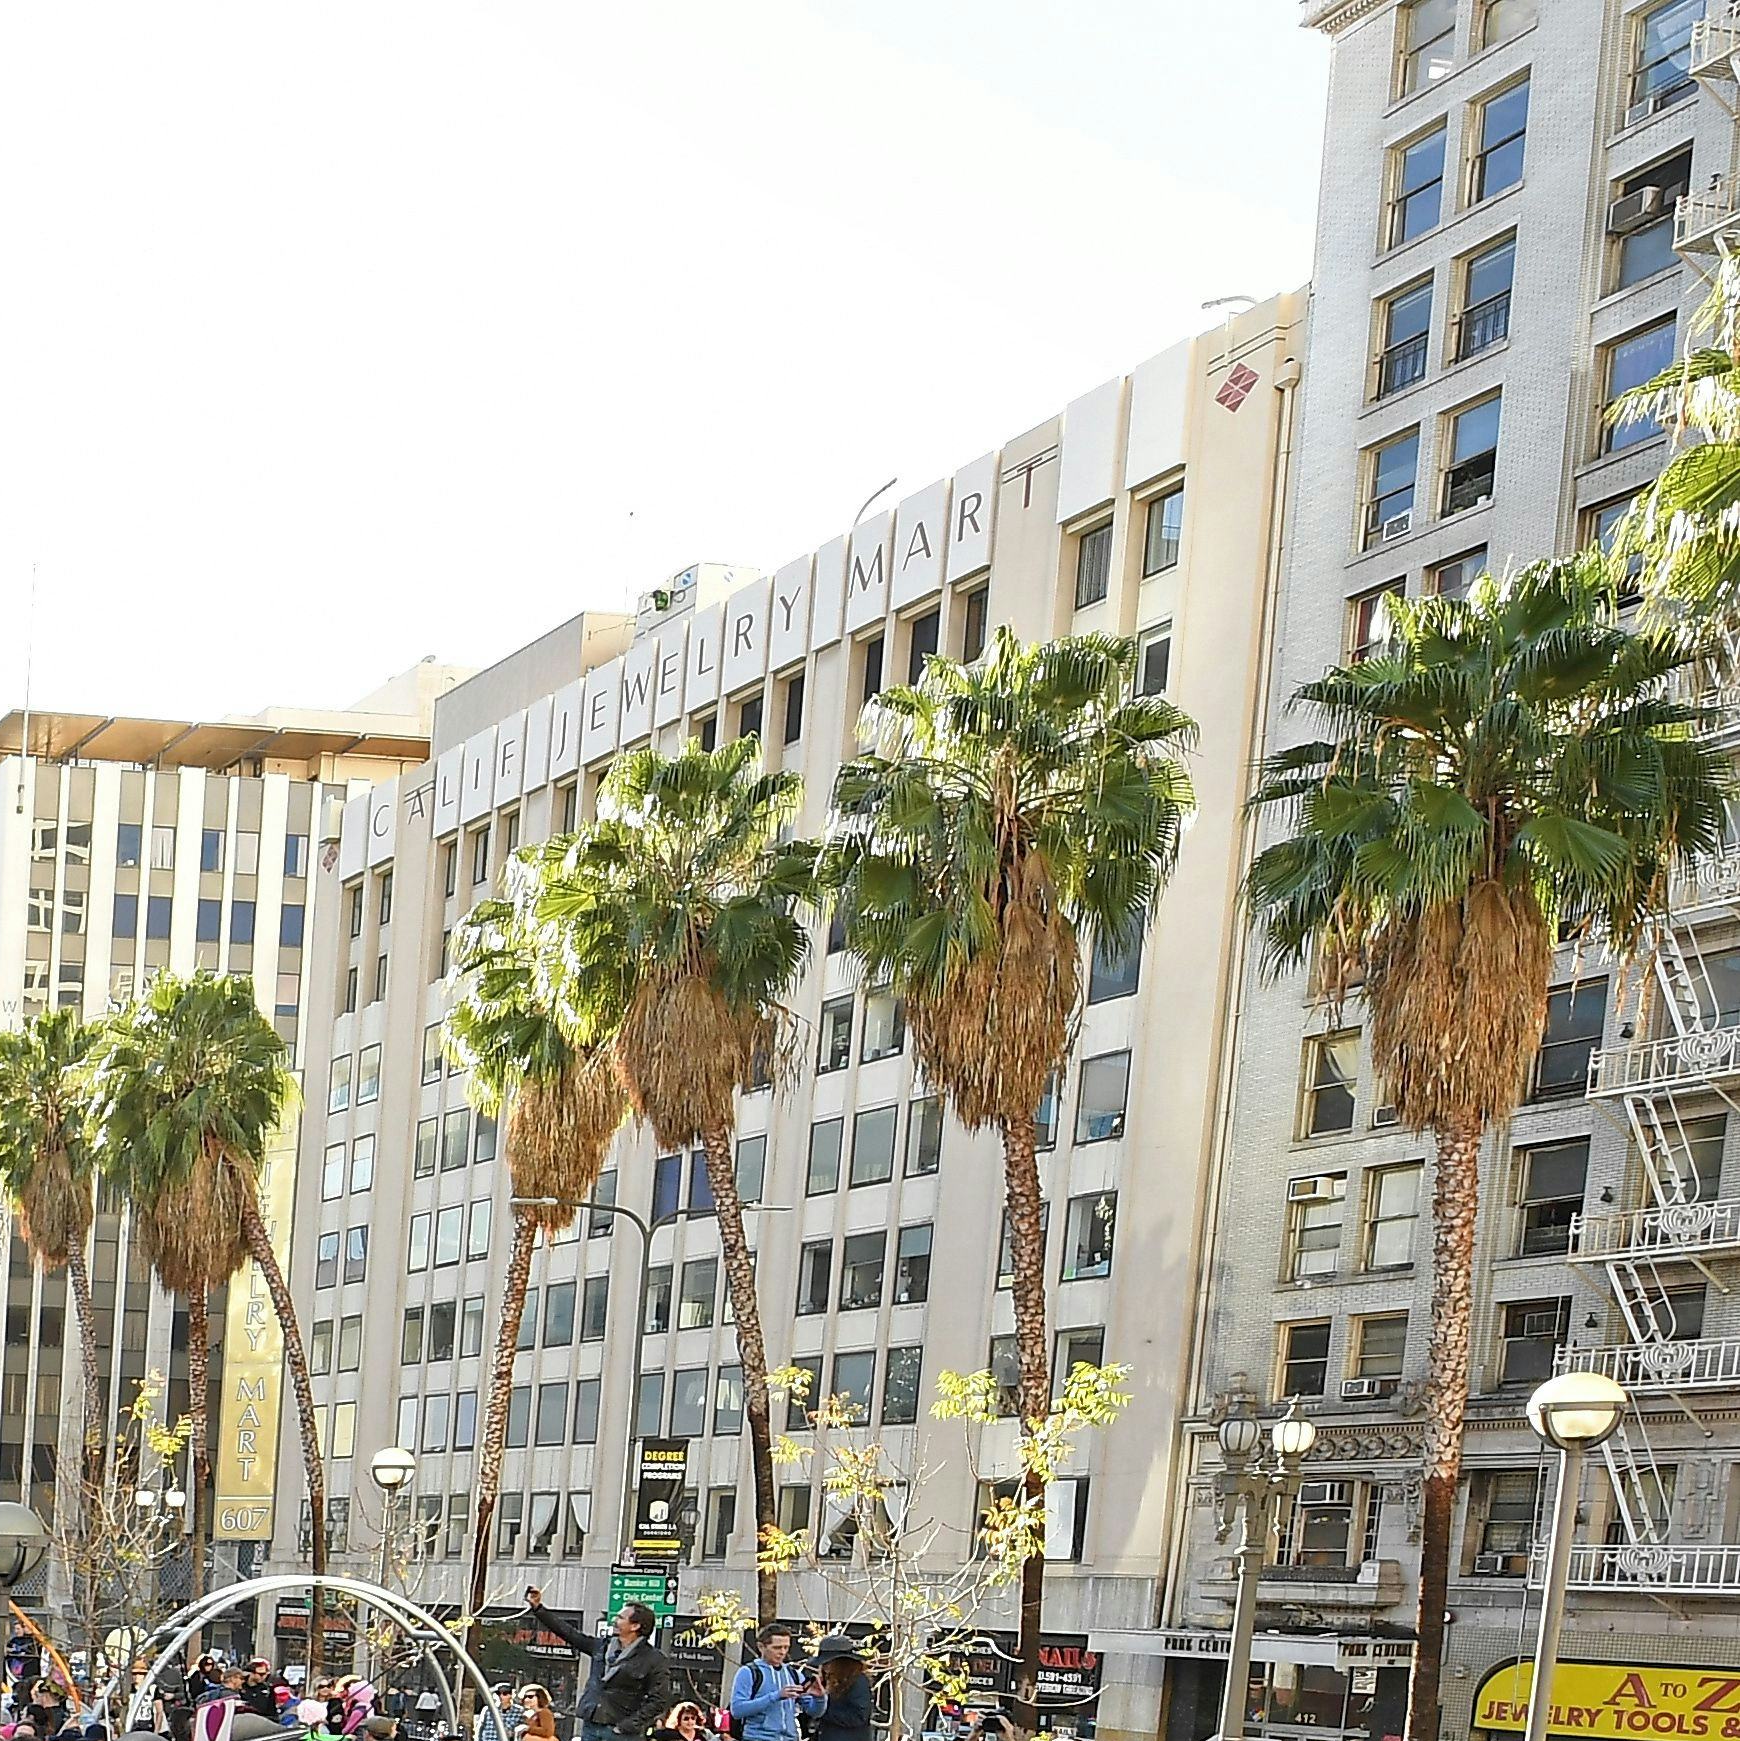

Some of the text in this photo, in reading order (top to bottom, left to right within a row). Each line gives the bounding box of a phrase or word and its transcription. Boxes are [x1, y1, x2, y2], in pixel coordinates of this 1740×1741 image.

[555, 586, 802, 762] JEWELRY
[848, 462, 1043, 599] MART
[236, 1376, 265, 1482] MART
[644, 1451, 684, 1461] DEGREE
[220, 1507, 269, 1531] 607
[1603, 1673, 1740, 1713] A TO Z
[1294, 1713, 1317, 1724] 412
[1613, 1710, 1709, 1735] TOOLS
[1720, 1717, 1740, 1738] &
